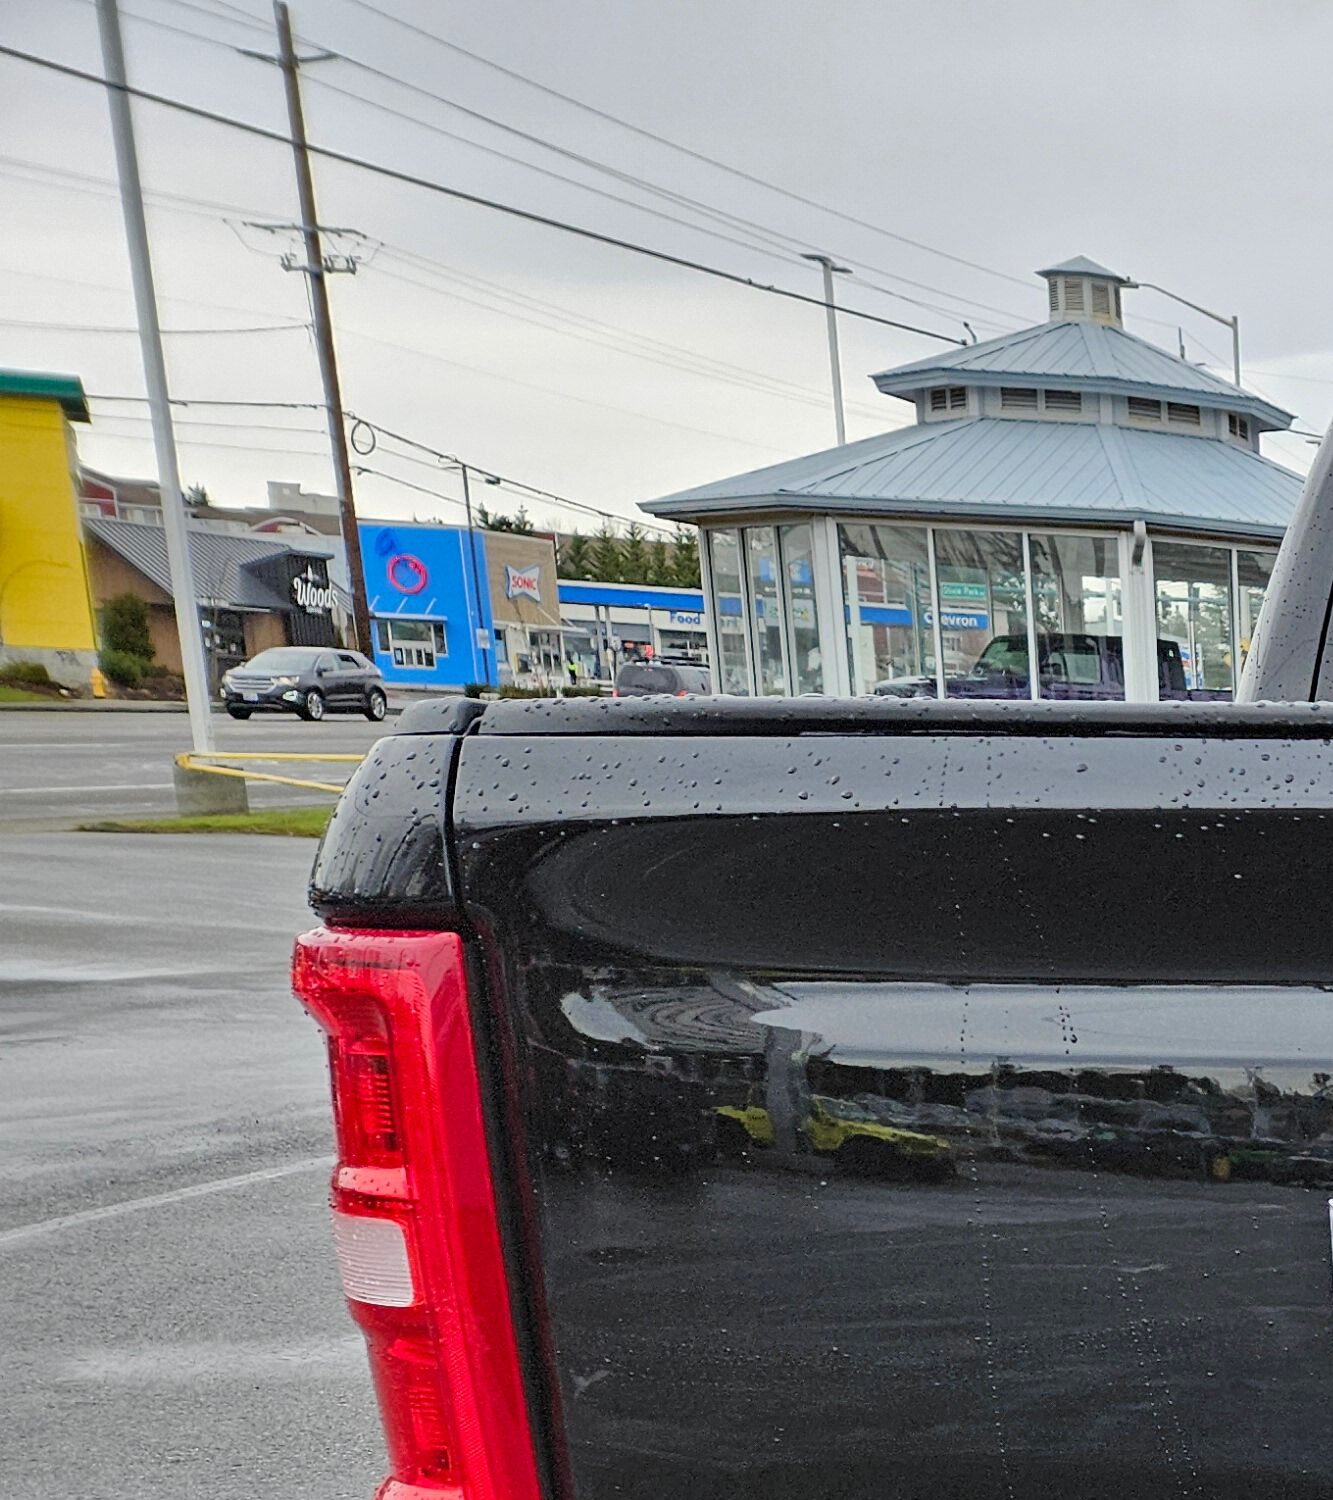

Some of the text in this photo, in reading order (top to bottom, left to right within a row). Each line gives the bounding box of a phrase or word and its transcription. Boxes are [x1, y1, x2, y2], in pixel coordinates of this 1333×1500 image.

[511, 575, 536, 590] SONIC
[294, 577, 338, 608] Woods
[670, 610, 701, 625] Food
[924, 613, 978, 627] Cevron
